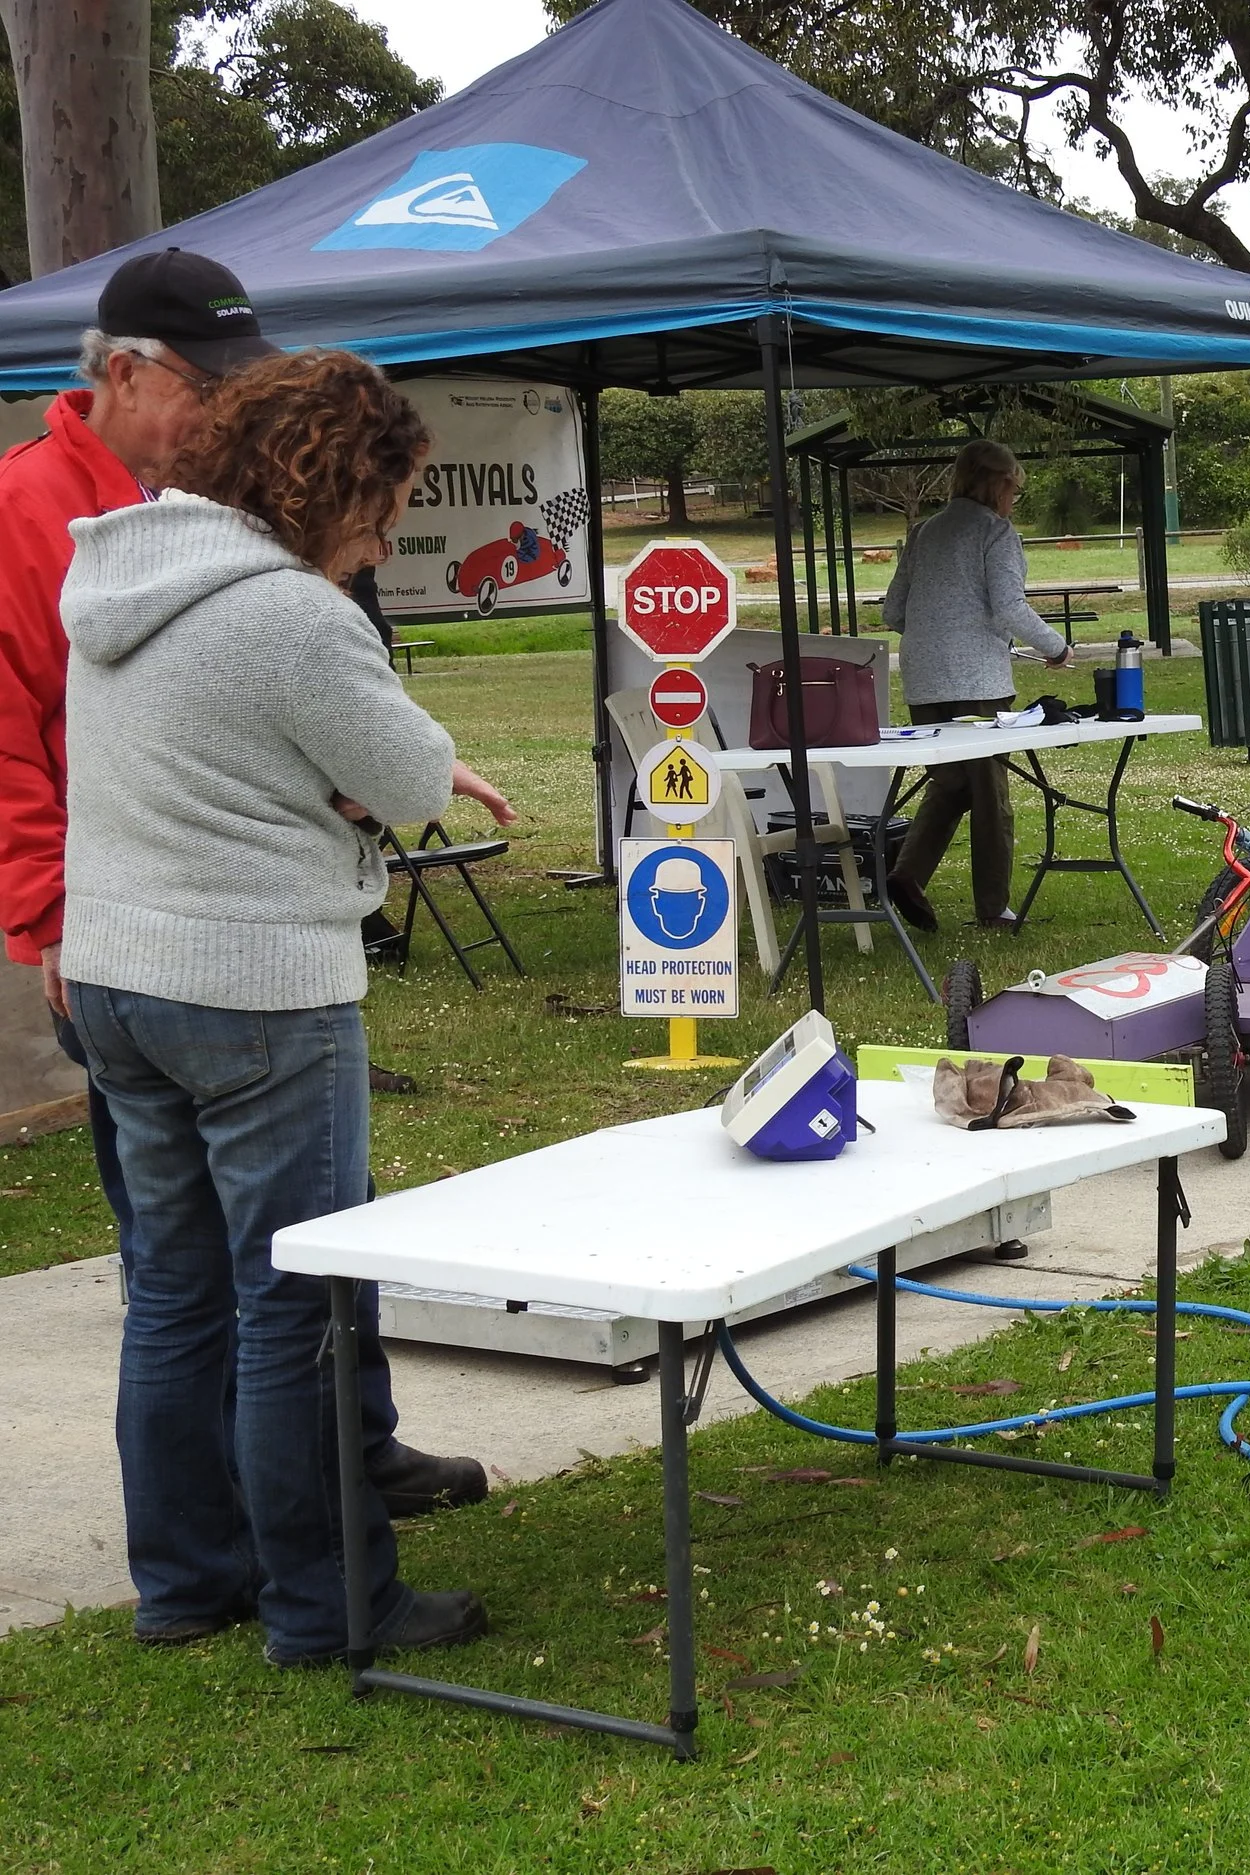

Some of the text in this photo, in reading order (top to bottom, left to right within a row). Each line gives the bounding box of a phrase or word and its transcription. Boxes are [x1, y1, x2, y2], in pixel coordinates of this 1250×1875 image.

[397, 535, 447, 556] SUNDAY
[504, 560, 516, 578] 19
[396, 585, 427, 597] Festival
[633, 586, 721, 614] STOP
[626, 960, 732, 976] HEAD PROTECTION
[635, 988, 725, 1004] MUST BE WORN
